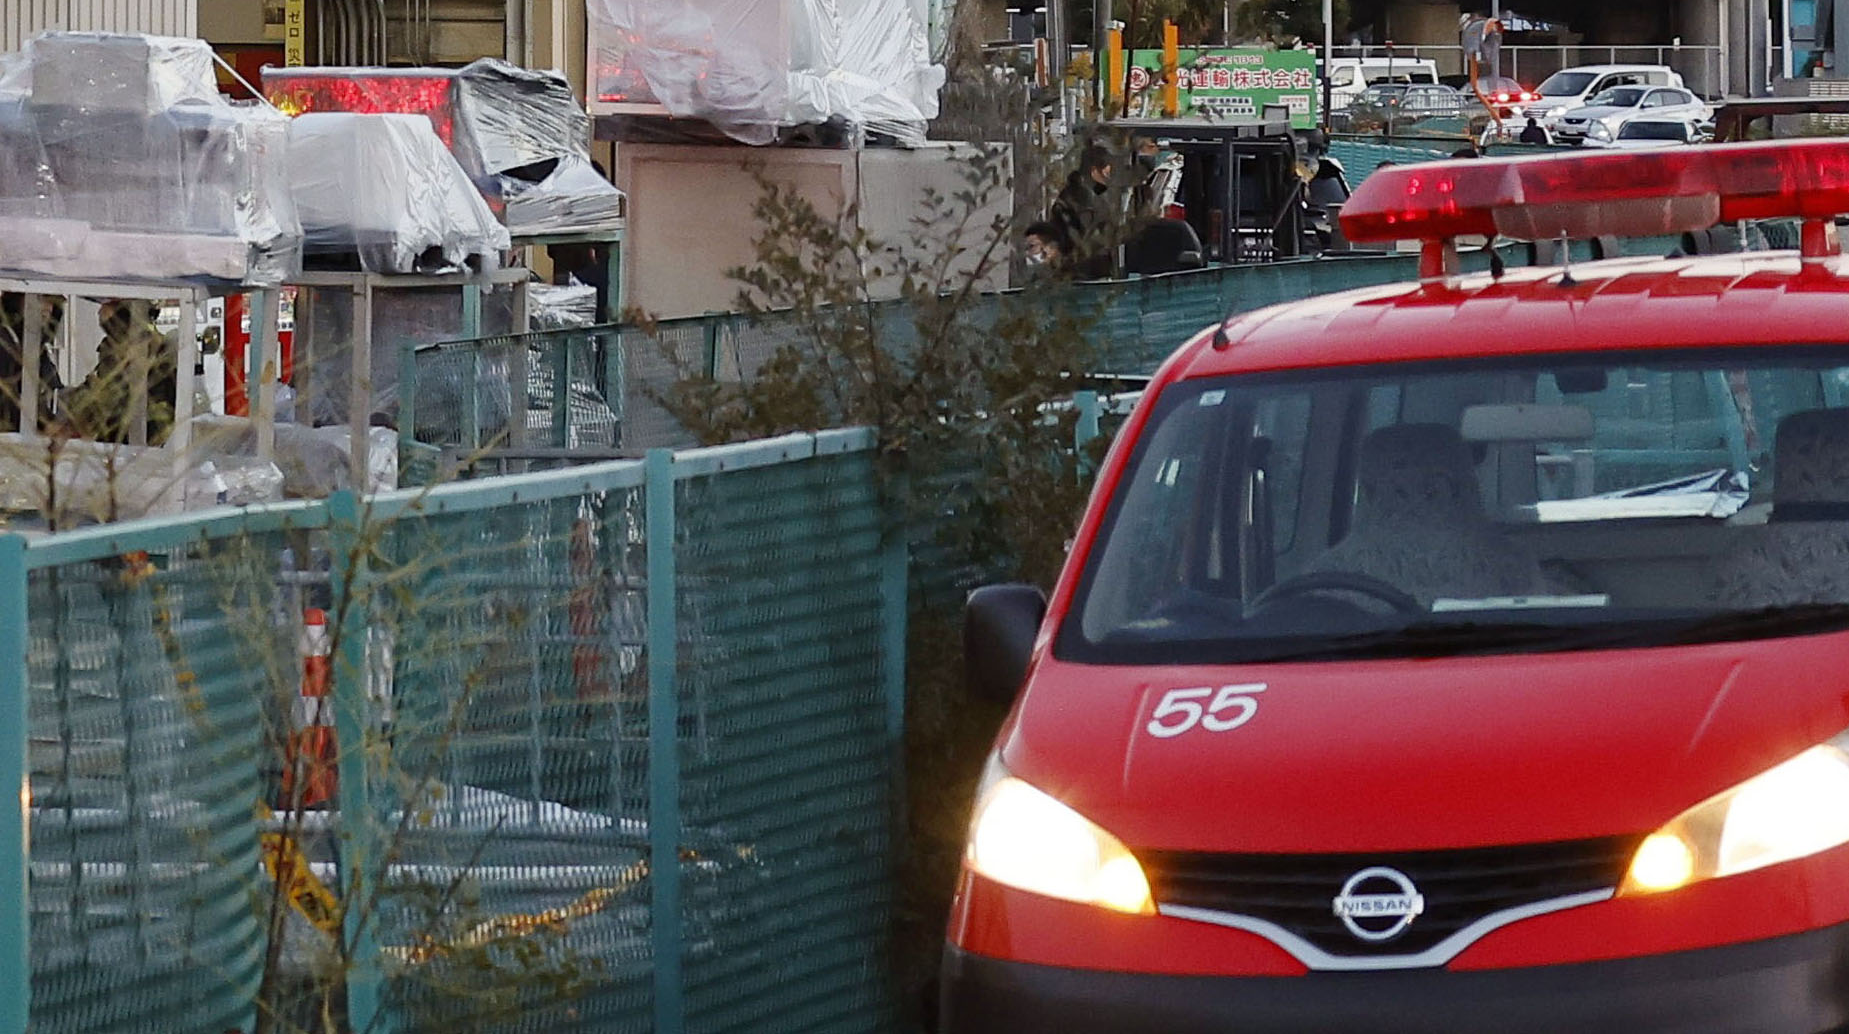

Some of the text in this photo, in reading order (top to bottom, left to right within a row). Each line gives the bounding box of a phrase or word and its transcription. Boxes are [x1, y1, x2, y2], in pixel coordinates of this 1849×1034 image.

[288, 11, 301, 38] ゼロ
[288, 47, 301, 67] 災
[1154, 68, 1312, 89] 光運輸株式会社
[1146, 682, 1268, 738] 55
[1342, 900, 1412, 912] NISSAN
